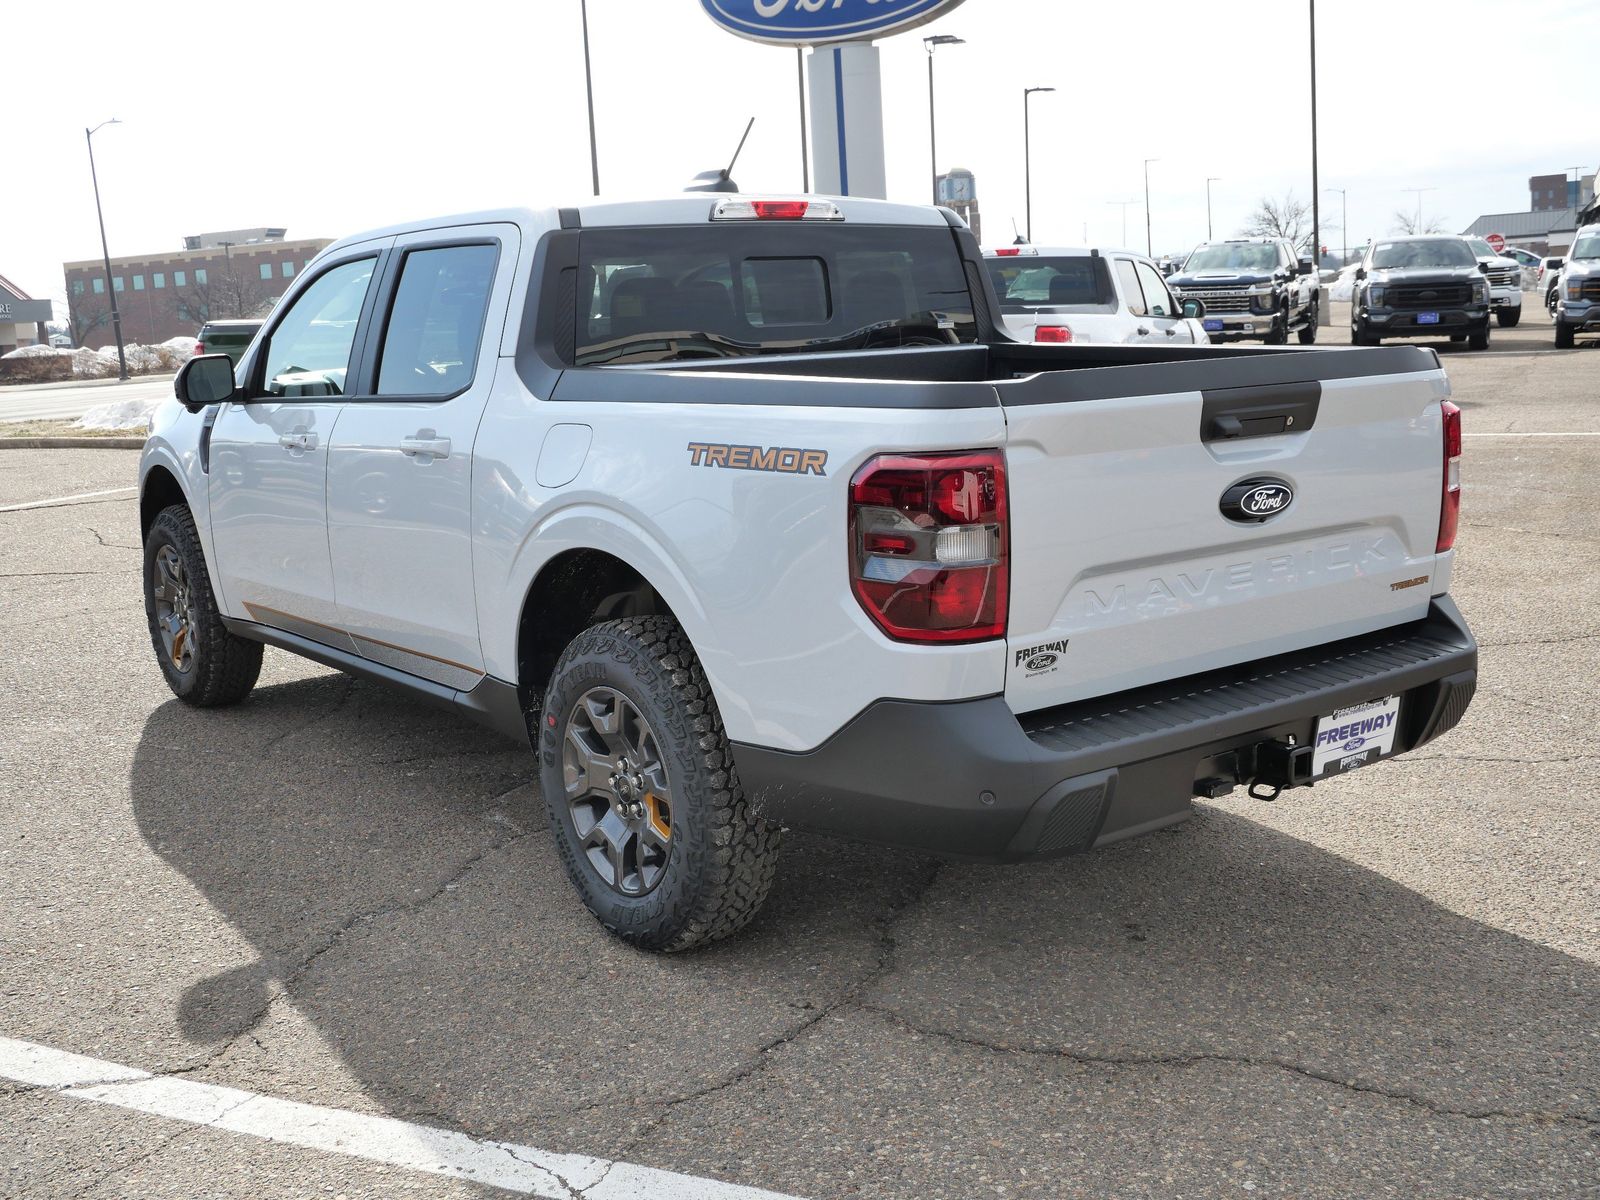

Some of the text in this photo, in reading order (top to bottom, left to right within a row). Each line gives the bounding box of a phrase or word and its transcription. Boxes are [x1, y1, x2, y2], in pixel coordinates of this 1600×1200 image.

[687, 441, 828, 477] TREMOR
[1251, 488, 1284, 512] Ford
[1084, 536, 1386, 617] MAVERICK
[1390, 575, 1429, 591] TREMOR
[1015, 638, 1069, 668] FREEWAY
[1316, 710, 1397, 748] FREEWAY
